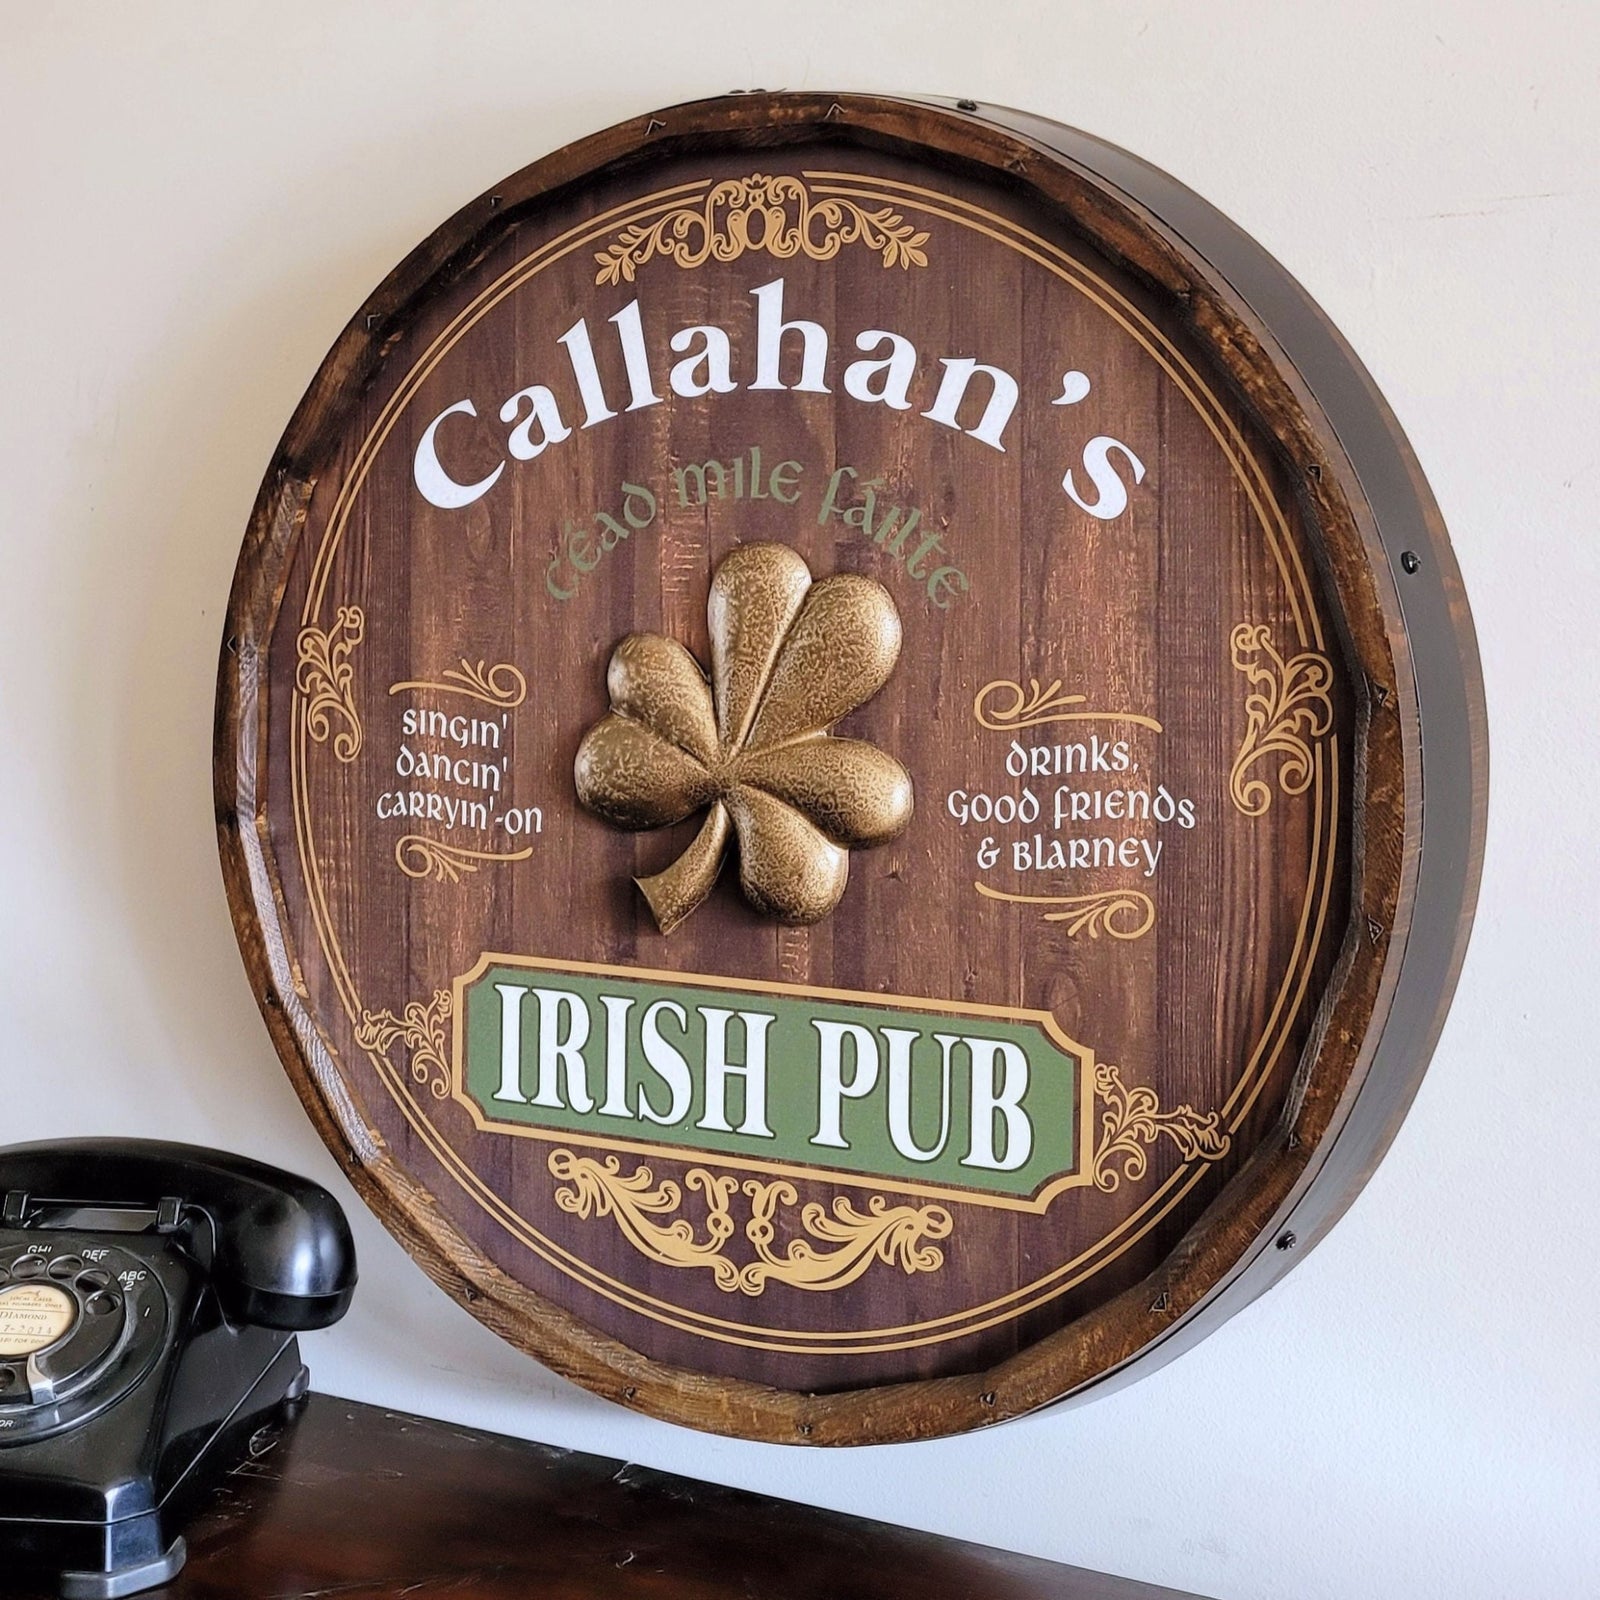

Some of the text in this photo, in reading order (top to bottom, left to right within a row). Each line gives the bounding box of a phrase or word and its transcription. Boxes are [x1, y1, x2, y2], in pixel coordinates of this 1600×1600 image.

[412, 278, 1147, 521] Callahan's
[976, 836, 1001, 870] &
[492, 984, 1033, 1171] IRISH PUB
[118, 1270, 147, 1281] ABC
[123, 1281, 135, 1291] 2
